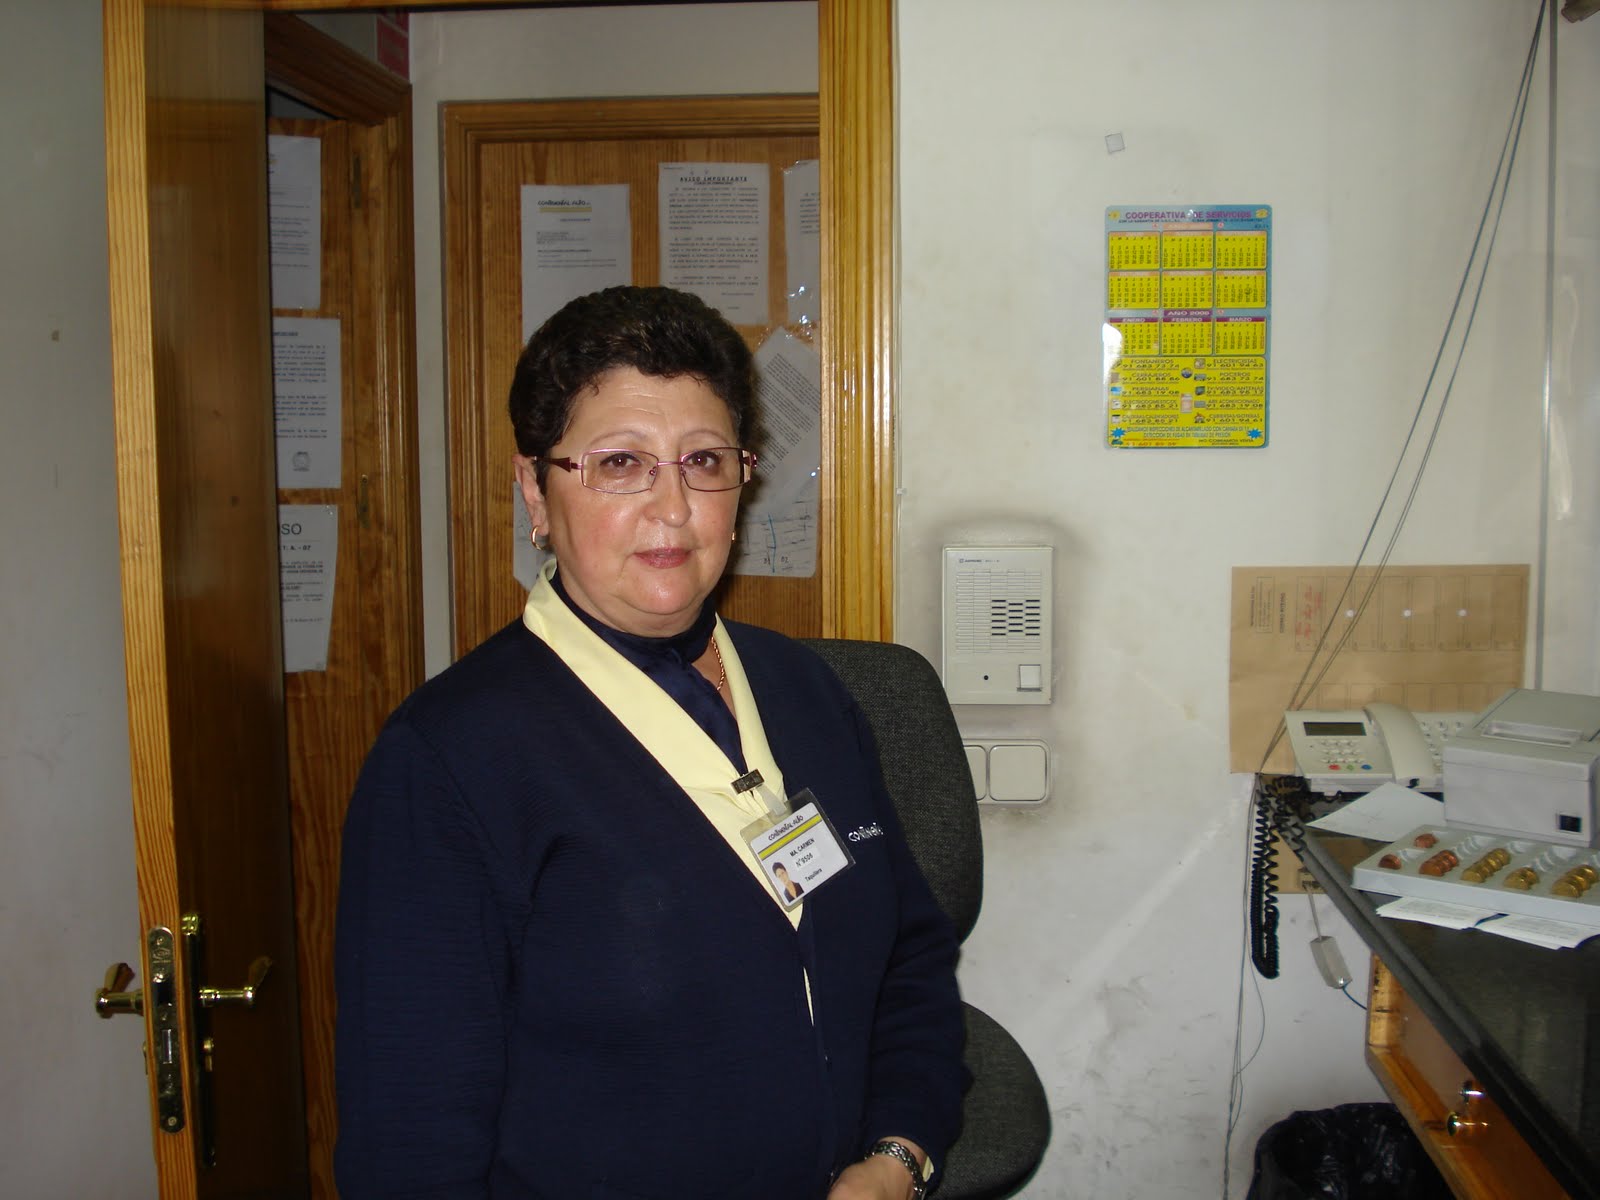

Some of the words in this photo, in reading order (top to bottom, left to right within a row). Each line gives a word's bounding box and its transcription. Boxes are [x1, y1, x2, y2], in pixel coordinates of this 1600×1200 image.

[1125, 211, 1185, 219] COOPERATIVA
[1206, 210, 1252, 218] SERVICIOS
[281, 523, 302, 536] SO
[797, 838, 815, 852] CARMEN
